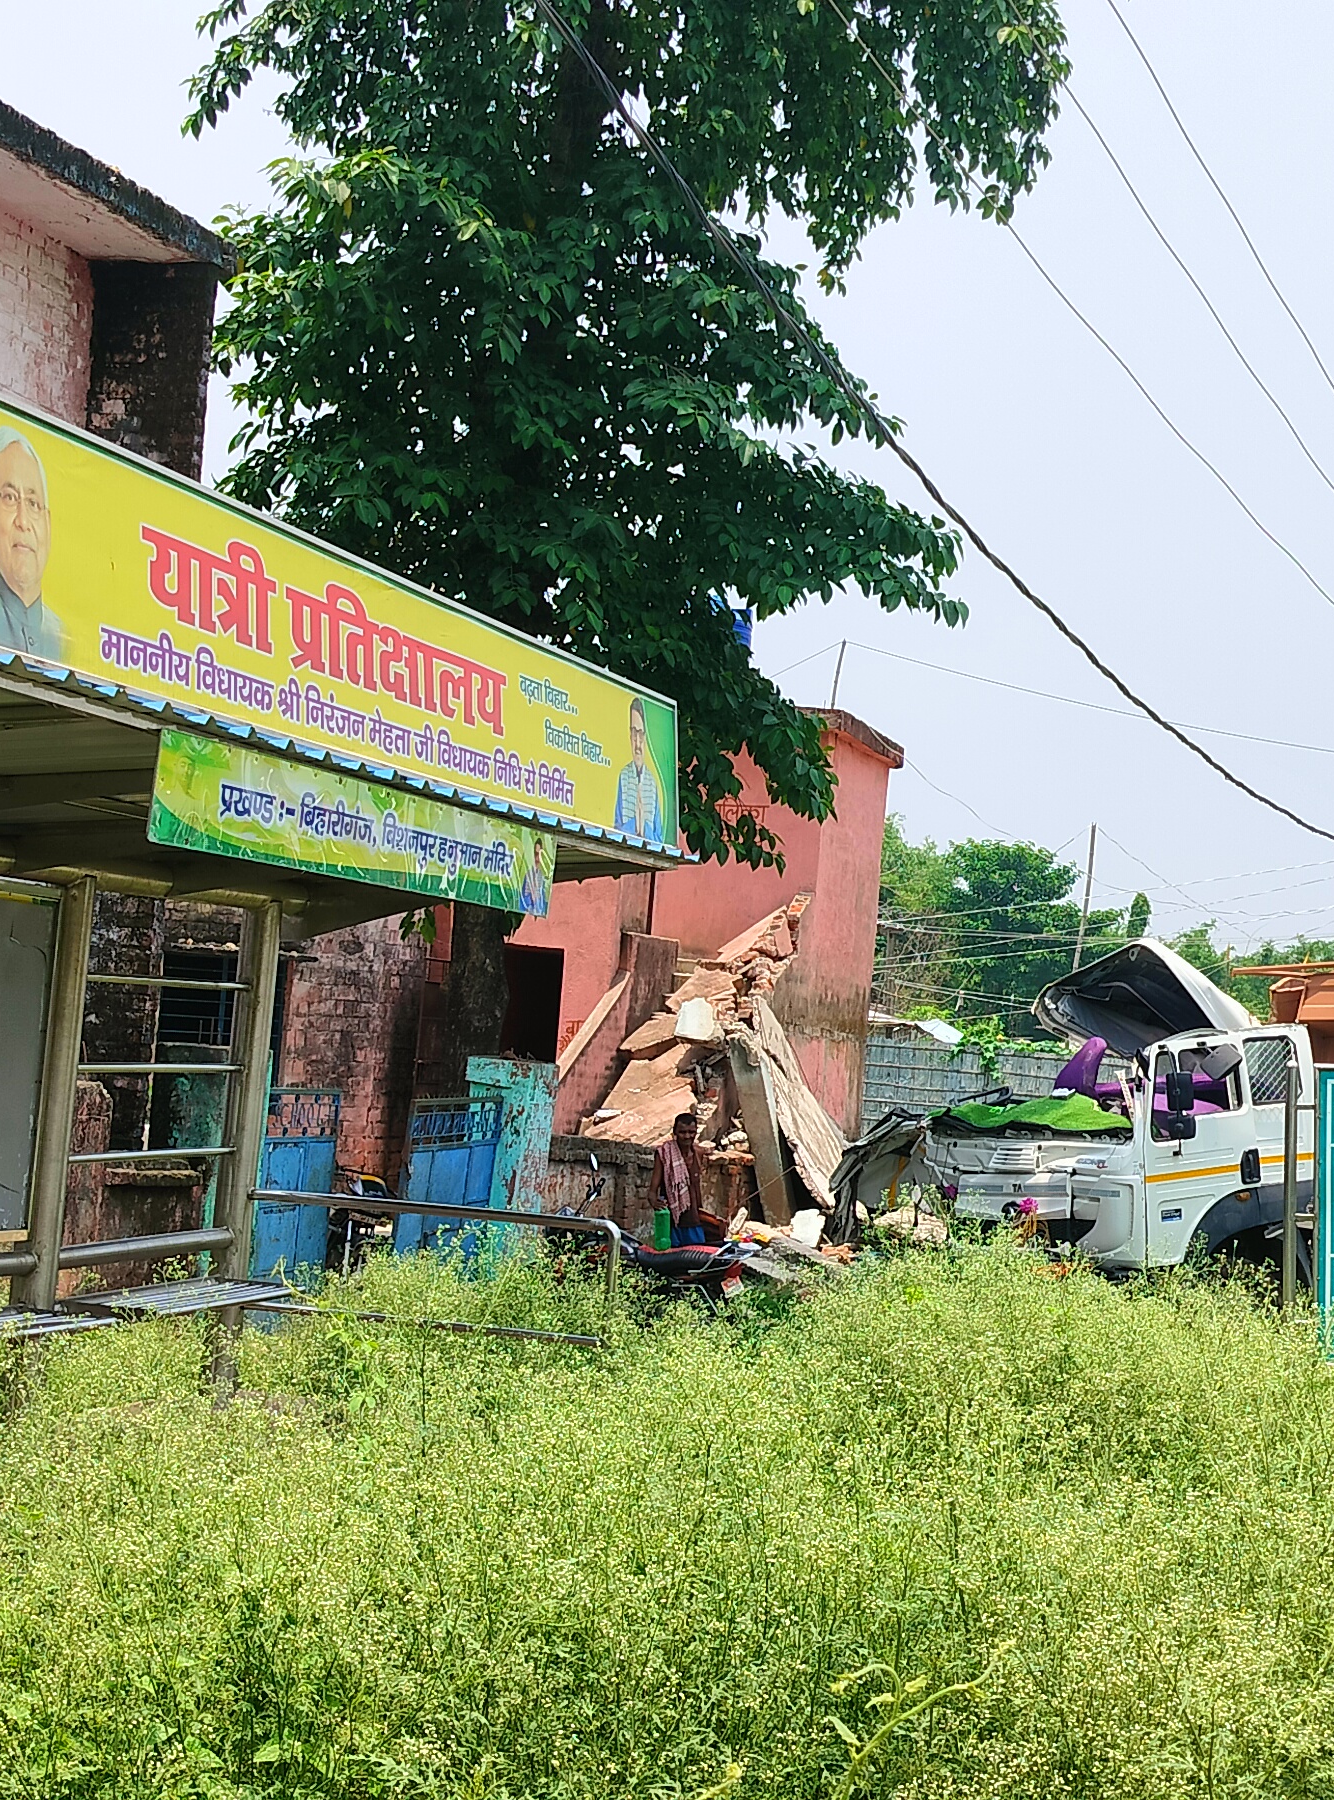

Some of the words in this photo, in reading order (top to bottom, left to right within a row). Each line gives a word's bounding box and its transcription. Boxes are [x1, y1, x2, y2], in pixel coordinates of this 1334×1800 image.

[141, 523, 276, 655] यात्री
[285, 583, 506, 736] प्रतिक्षालय
[101, 627, 191, 685] माननीय
[196, 648, 274, 712] विधायक
[277, 677, 303, 724] श्री
[305, 685, 365, 741] निरंजन
[370, 708, 411, 753] मेहता
[414, 720, 435, 763] जी
[438, 729, 492, 781] विधायक
[494, 749, 522, 791] निधि
[525, 763, 536, 794] से
[539, 763, 574, 807] निर्मित
[545, 718, 580, 755] विकसित
[220, 783, 276, 824] प्रखण्ड
[299, 792, 376, 847] बिहारीगंज,
